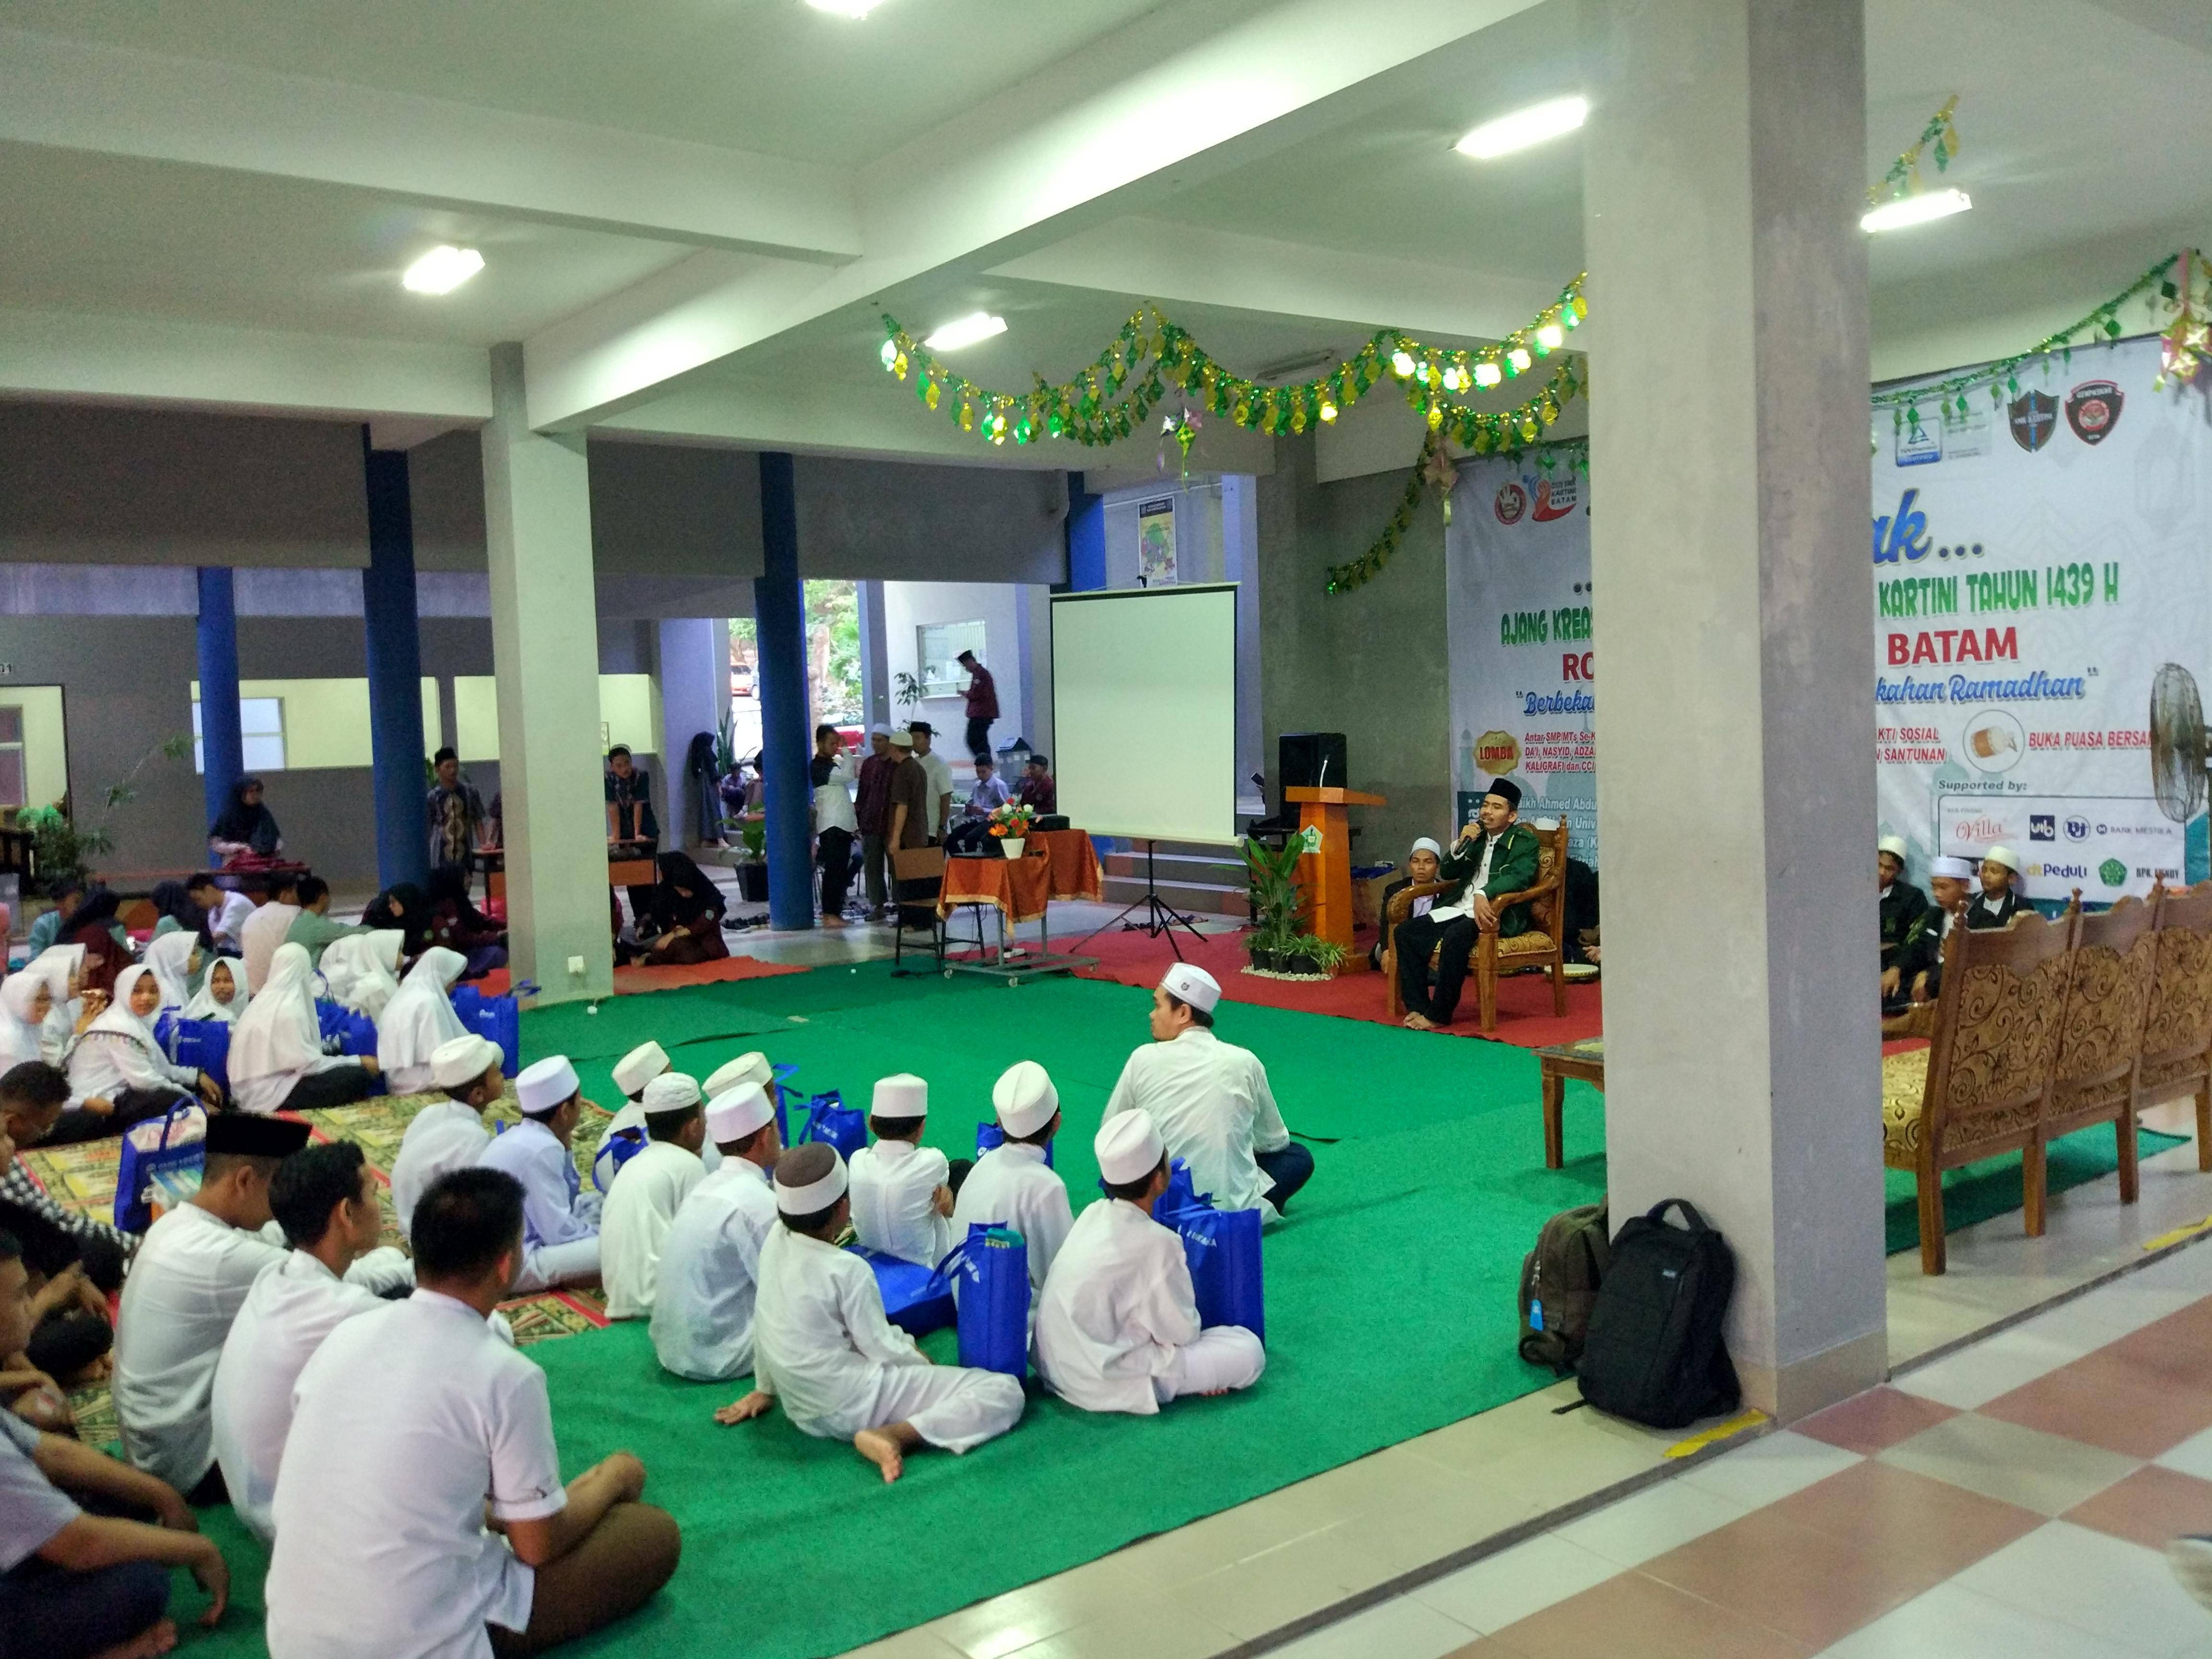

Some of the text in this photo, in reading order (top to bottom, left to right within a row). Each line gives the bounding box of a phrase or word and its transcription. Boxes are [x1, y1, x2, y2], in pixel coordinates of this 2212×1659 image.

[1878, 576, 1958, 617] KARTINI
[1966, 570, 2037, 613] TAHUN
[2104, 562, 2118, 602] H
[1501, 605, 1593, 645] AJANG KREA
[1887, 626, 2018, 665] BATAM
[1524, 732, 1544, 742] Antar
[1899, 727, 1939, 740] SOSIAL
[2028, 730, 2152, 747] BUKA PUASA BERSA
[1479, 745, 1514, 760] LOMBA
[1574, 745, 1596, 756] ADZA
[1884, 747, 1946, 761] SANTUNAN
[1525, 761, 1564, 770] KALIGRAFI
[1566, 760, 1579, 770] dan
[1938, 780, 2028, 792] Supported by:
[1539, 796, 1570, 810] Ahmed
[1956, 817, 2003, 841] Villa
[1568, 838, 1584, 848] aza
